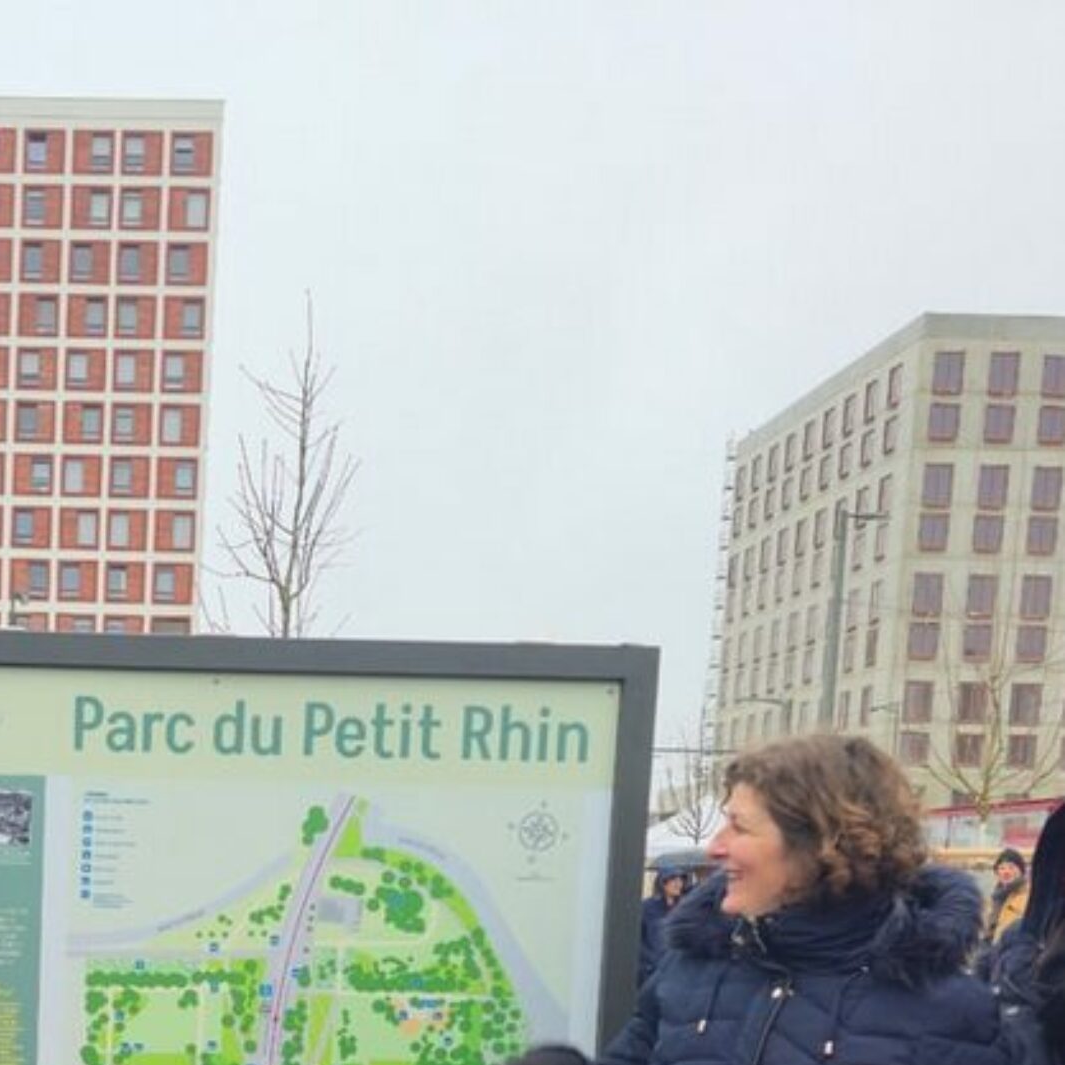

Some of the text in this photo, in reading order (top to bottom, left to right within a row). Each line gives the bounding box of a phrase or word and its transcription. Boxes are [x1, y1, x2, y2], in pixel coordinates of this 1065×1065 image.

[73, 696, 590, 763] Parc du Petit Rhin
